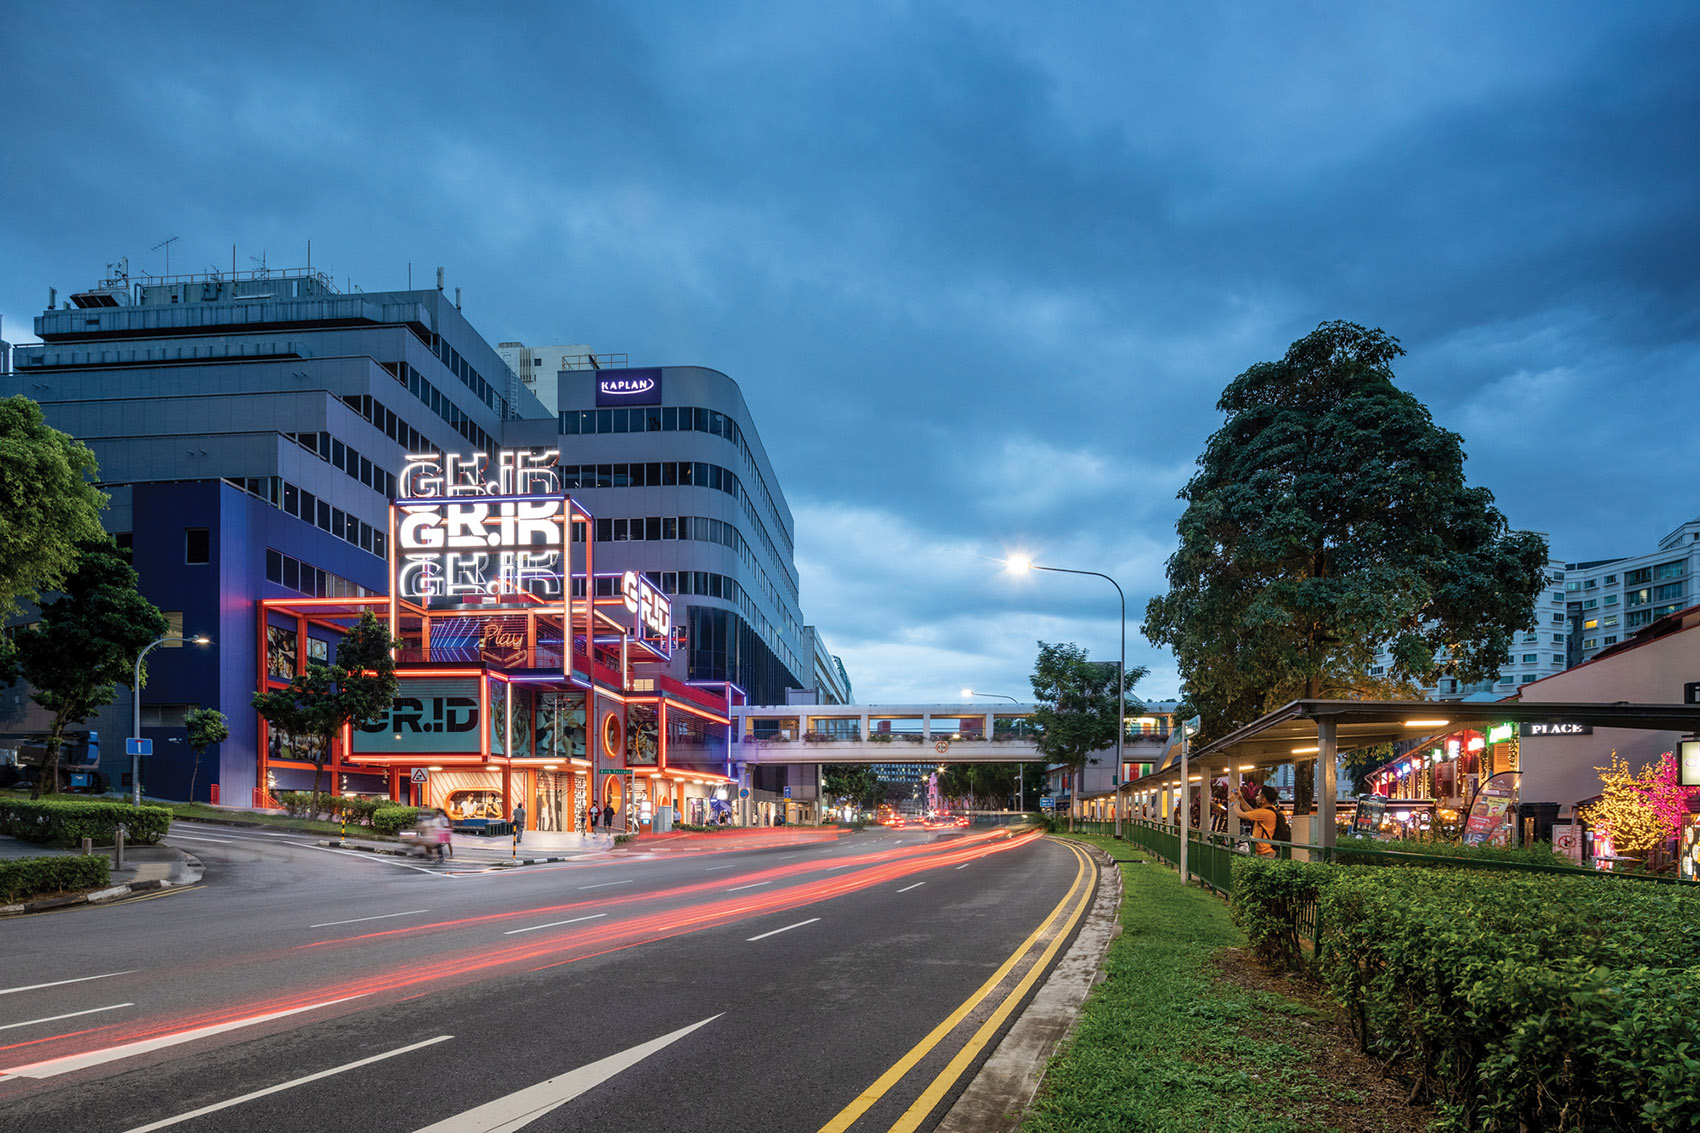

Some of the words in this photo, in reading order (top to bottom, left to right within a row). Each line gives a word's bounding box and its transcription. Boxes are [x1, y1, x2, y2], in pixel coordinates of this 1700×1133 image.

[601, 380, 647, 390] KAPLAN
[483, 624, 524, 650] Play
[1531, 724, 1583, 734] PLACE
